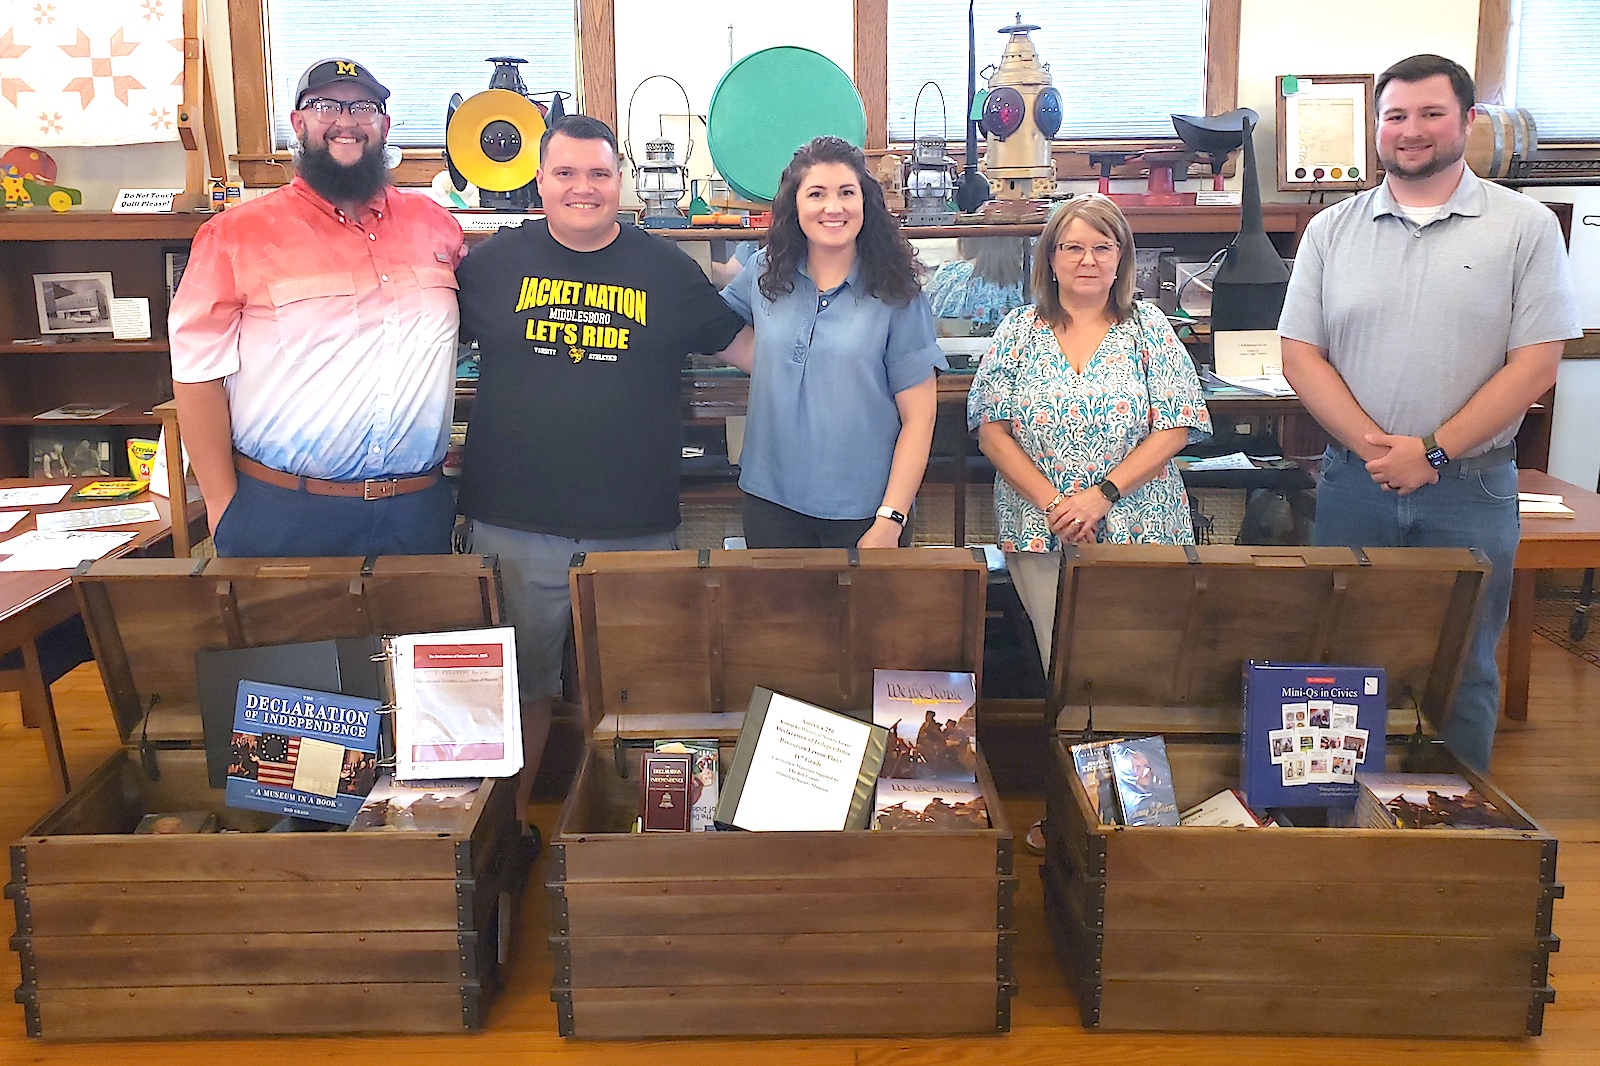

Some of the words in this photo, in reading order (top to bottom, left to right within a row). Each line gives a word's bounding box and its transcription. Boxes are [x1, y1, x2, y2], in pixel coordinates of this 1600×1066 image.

[336, 61, 358, 76] M
[515, 276, 583, 312] JACKET
[584, 283, 646, 326] NATION
[549, 308, 611, 324] MIDDLESBORO
[526, 318, 578, 345] LET'S
[582, 324, 630, 350] RIDE
[534, 346, 557, 356] VARSITY
[588, 352, 618, 362] ATHLETICS
[132, 445, 154, 454] Crayola
[141, 465, 149, 473] 64
[1282, 688, 1318, 698] Mini-Qs
[1320, 688, 1330, 697] in
[1330, 688, 1358, 698] Civics
[246, 694, 369, 726] DECLARATION
[245, 710, 258, 719] OF
[264, 712, 367, 738] INDEPENDENCE
[802, 718, 824, 730] America
[776, 726, 807, 741] Declaration
[815, 739, 851, 756] Independence
[805, 757, 822, 767] Grade
[808, 748, 826, 758] Lesson
[827, 754, 842, 763] Plans
[256, 788, 262, 796] A
[264, 790, 296, 801] MUSEUM
[298, 794, 307, 802] IN
[308, 796, 315, 804] A
[316, 797, 338, 808] BOOK
